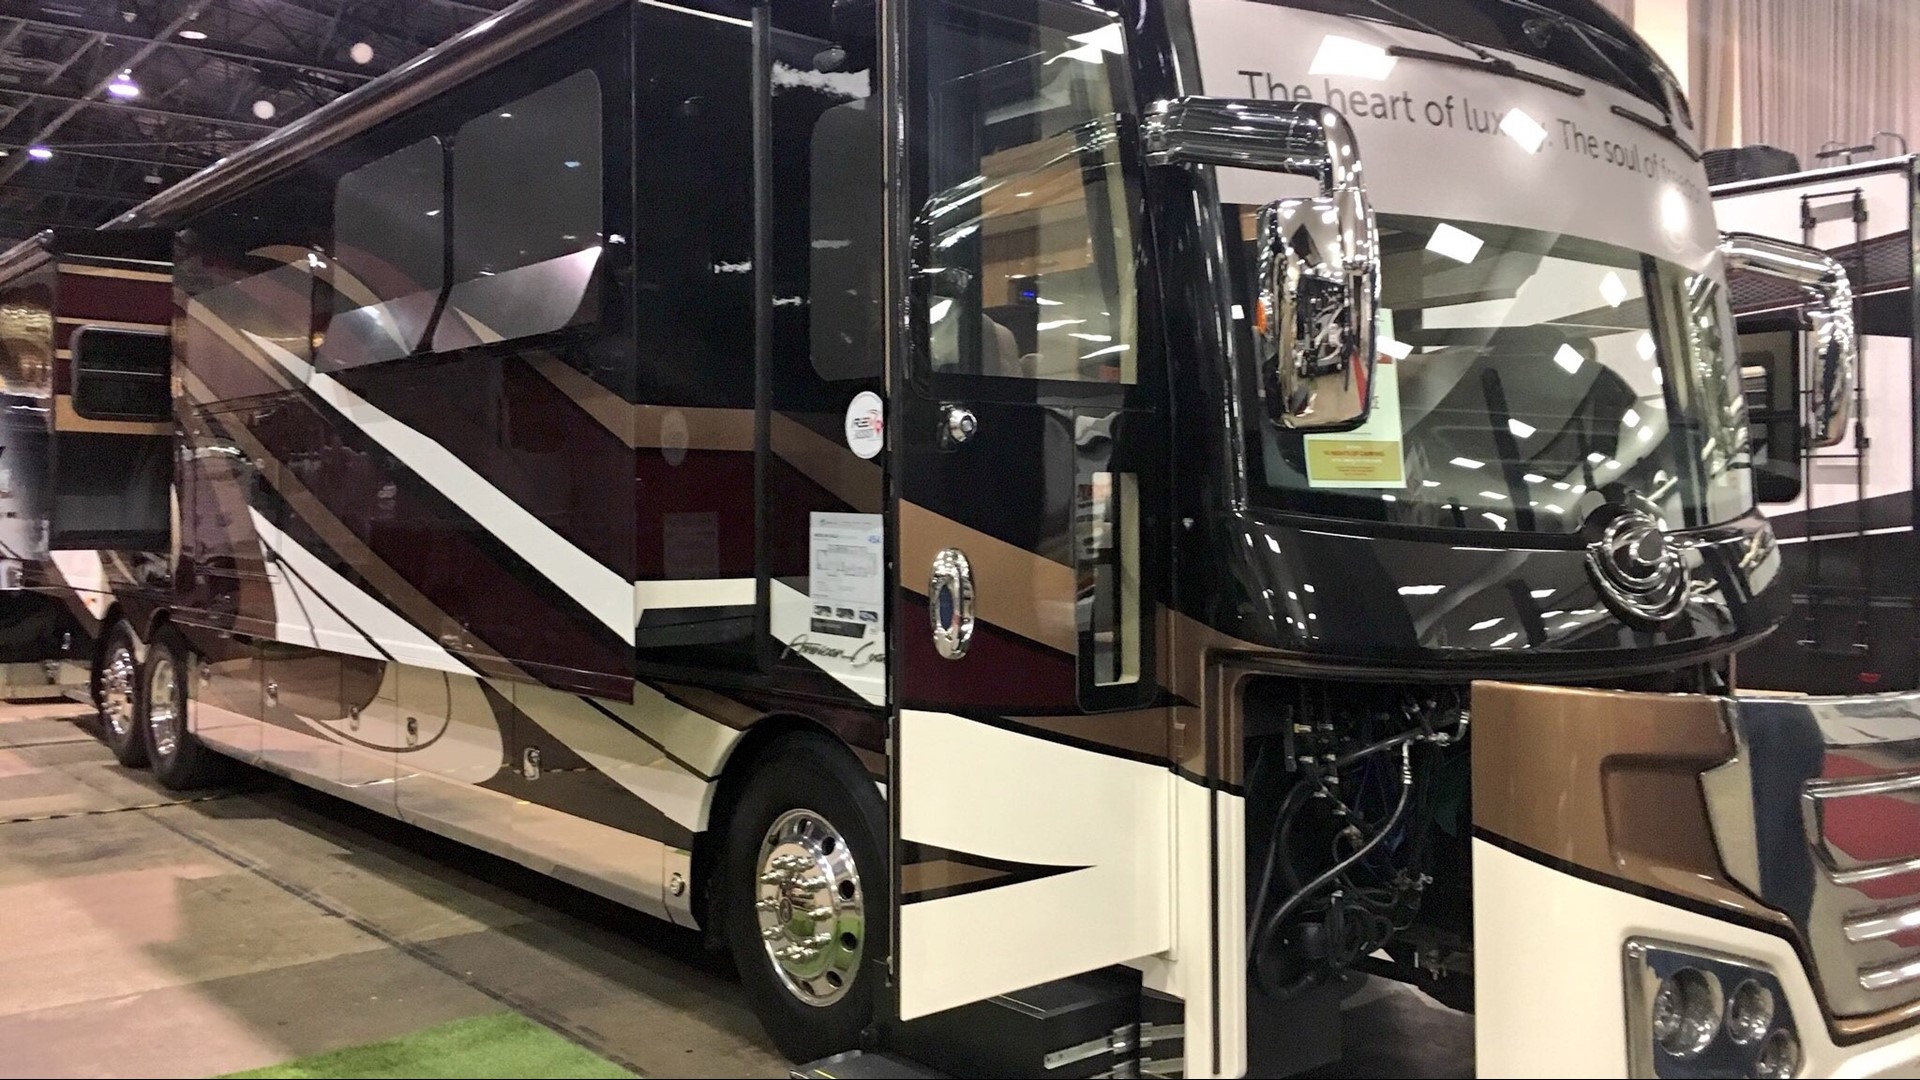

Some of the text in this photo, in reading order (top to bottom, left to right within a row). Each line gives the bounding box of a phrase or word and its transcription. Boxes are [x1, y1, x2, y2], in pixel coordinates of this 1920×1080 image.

[1237, 69, 1313, 101] The
[1323, 77, 1416, 123] heart
[1426, 95, 1456, 129] of
[1556, 117, 1599, 159] The
[1603, 139, 1641, 174] soul
[1644, 153, 1659, 179] of
